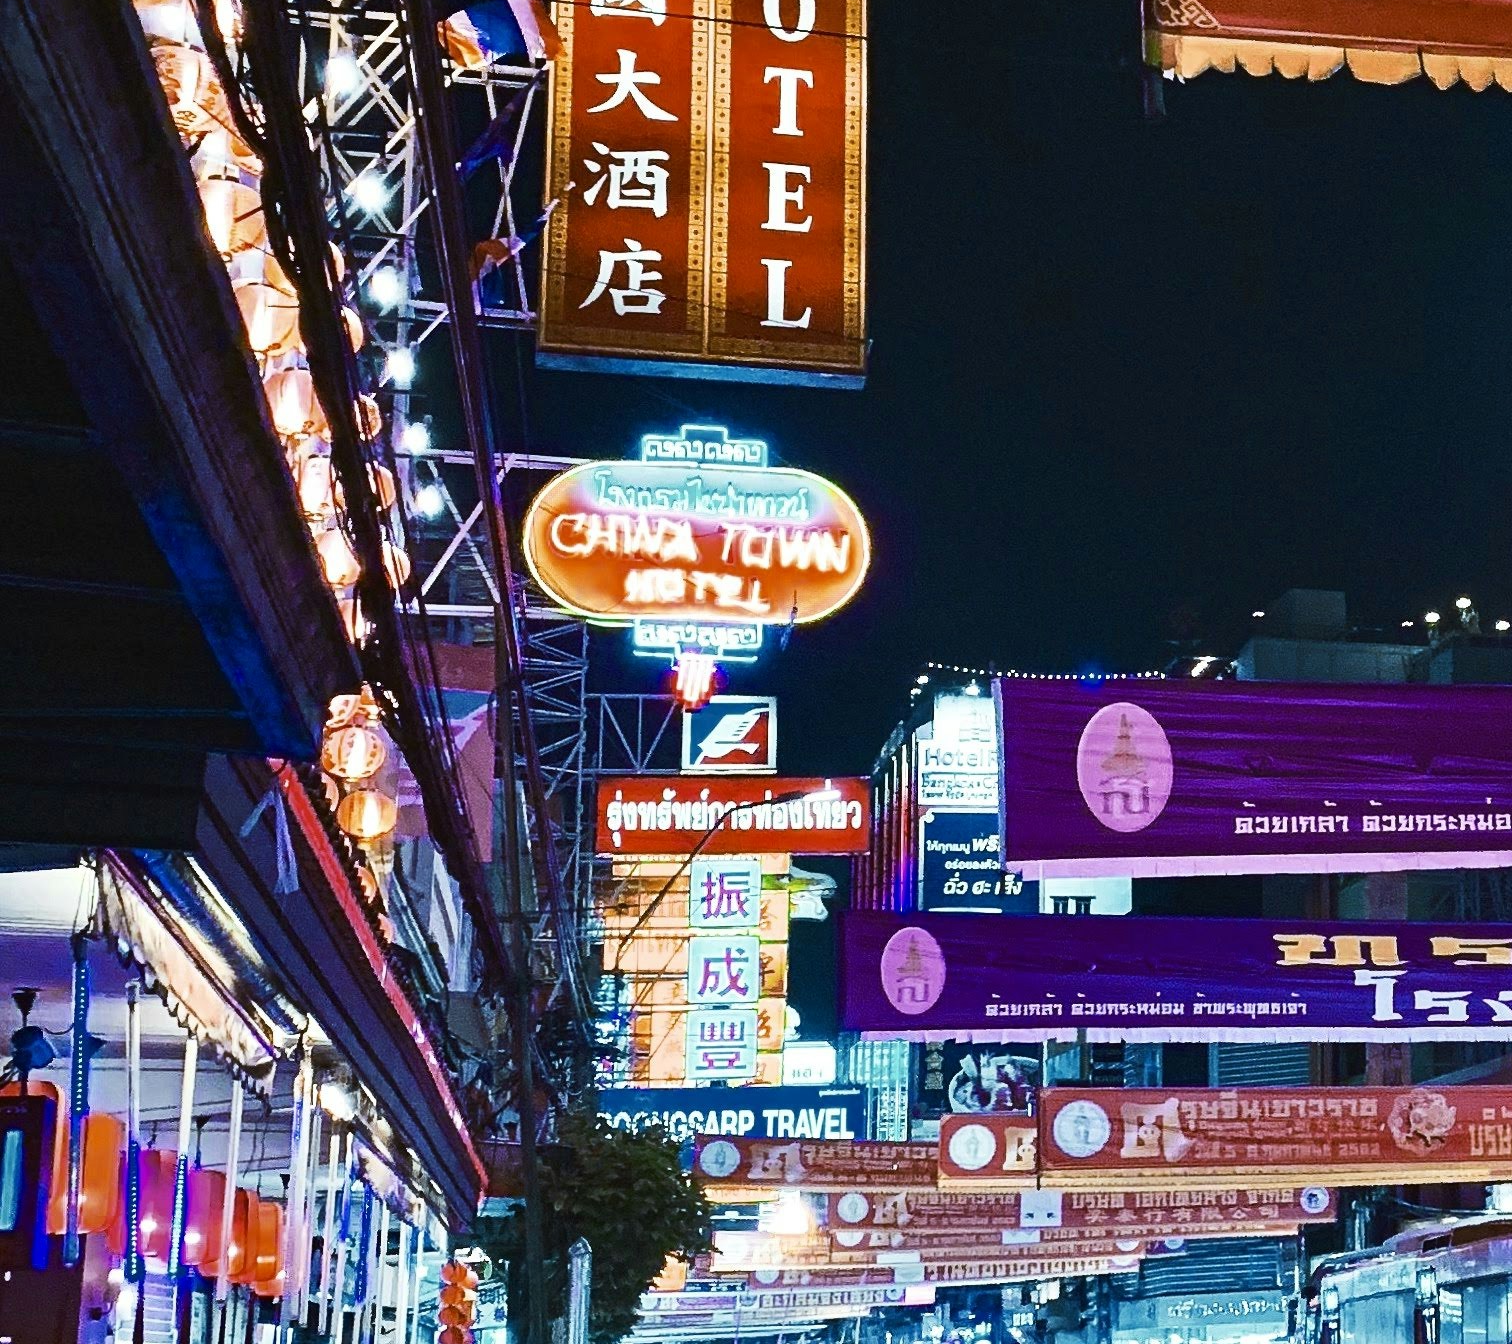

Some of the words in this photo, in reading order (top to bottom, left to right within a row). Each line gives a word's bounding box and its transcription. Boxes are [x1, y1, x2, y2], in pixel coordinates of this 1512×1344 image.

[551, 512, 699, 562] CHINA
[720, 522, 850, 573] TOWN
[924, 747, 983, 767] Hotel
[1235, 800, 1350, 835] ด้วยเกล้า
[696, 869, 752, 1071] 振成豐
[762, 1107, 855, 1140] TRAVEL
